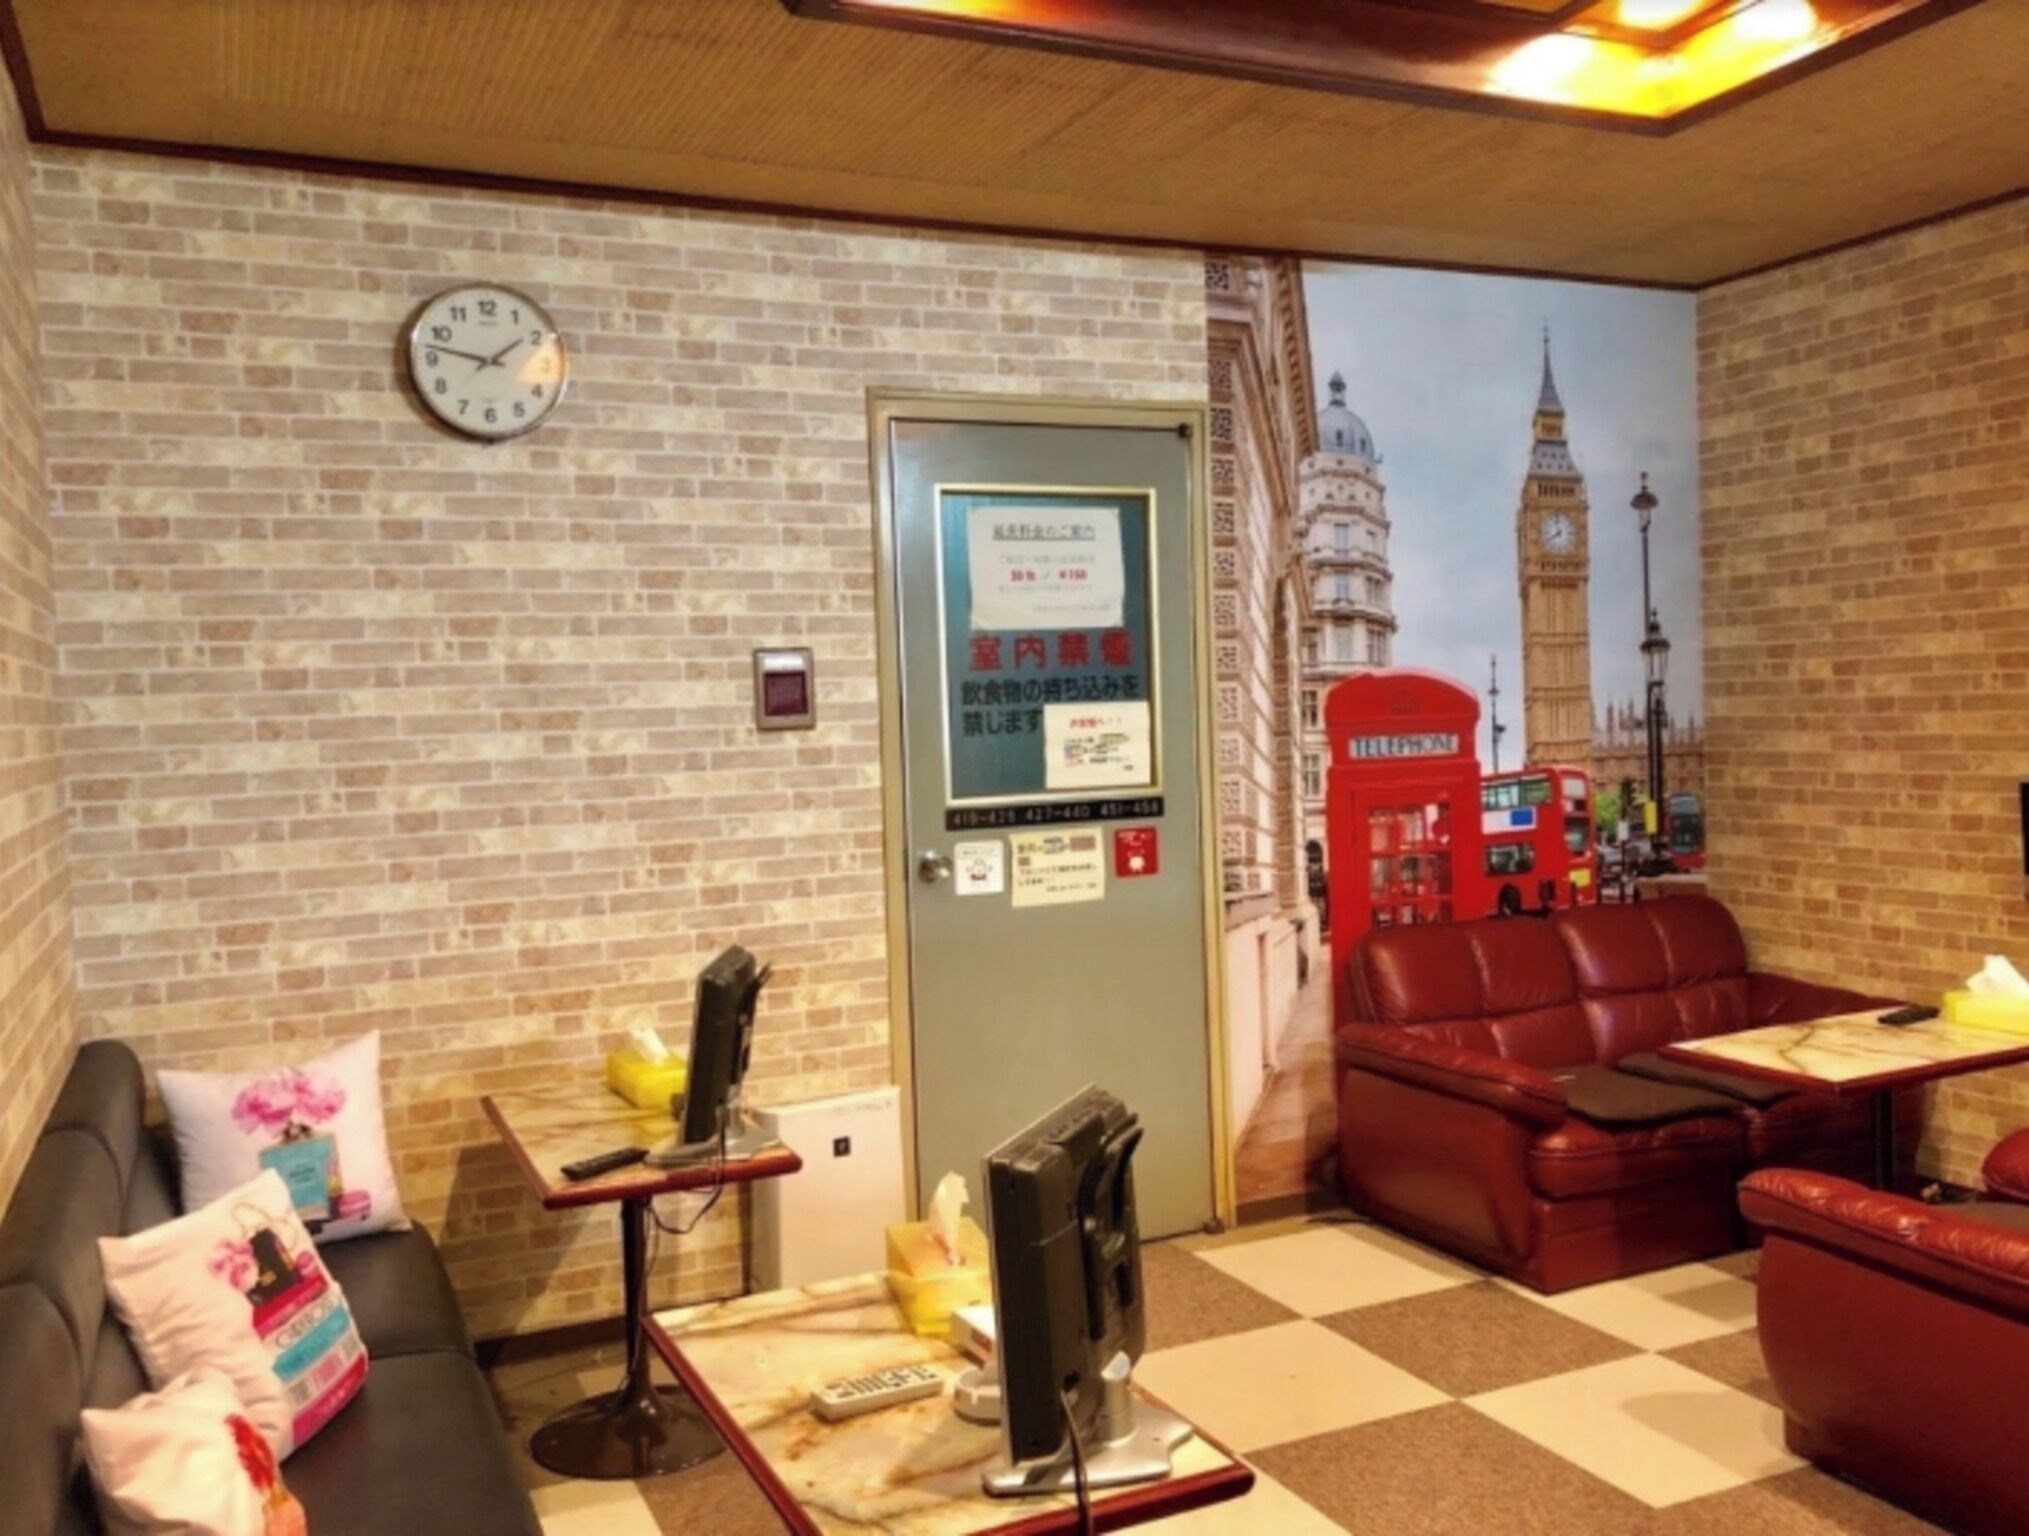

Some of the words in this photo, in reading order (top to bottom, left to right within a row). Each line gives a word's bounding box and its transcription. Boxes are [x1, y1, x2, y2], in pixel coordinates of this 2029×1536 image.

[450, 306, 467, 322] 11
[477, 299, 497, 317] 12
[510, 309, 520, 326] 1
[431, 325, 452, 342] 10
[530, 330, 542, 346] 2
[425, 352, 438, 367] 9
[434, 377, 447, 395] 8
[530, 384, 543, 398] 4
[457, 400, 469, 415] 7
[484, 407, 498, 423] 6
[513, 402, 526, 418] 5
[961, 675, 1140, 705] 飲食物の持ち込みを
[963, 708, 1044, 737] 禁します
[1354, 734, 1457, 757] TELEPHONE
